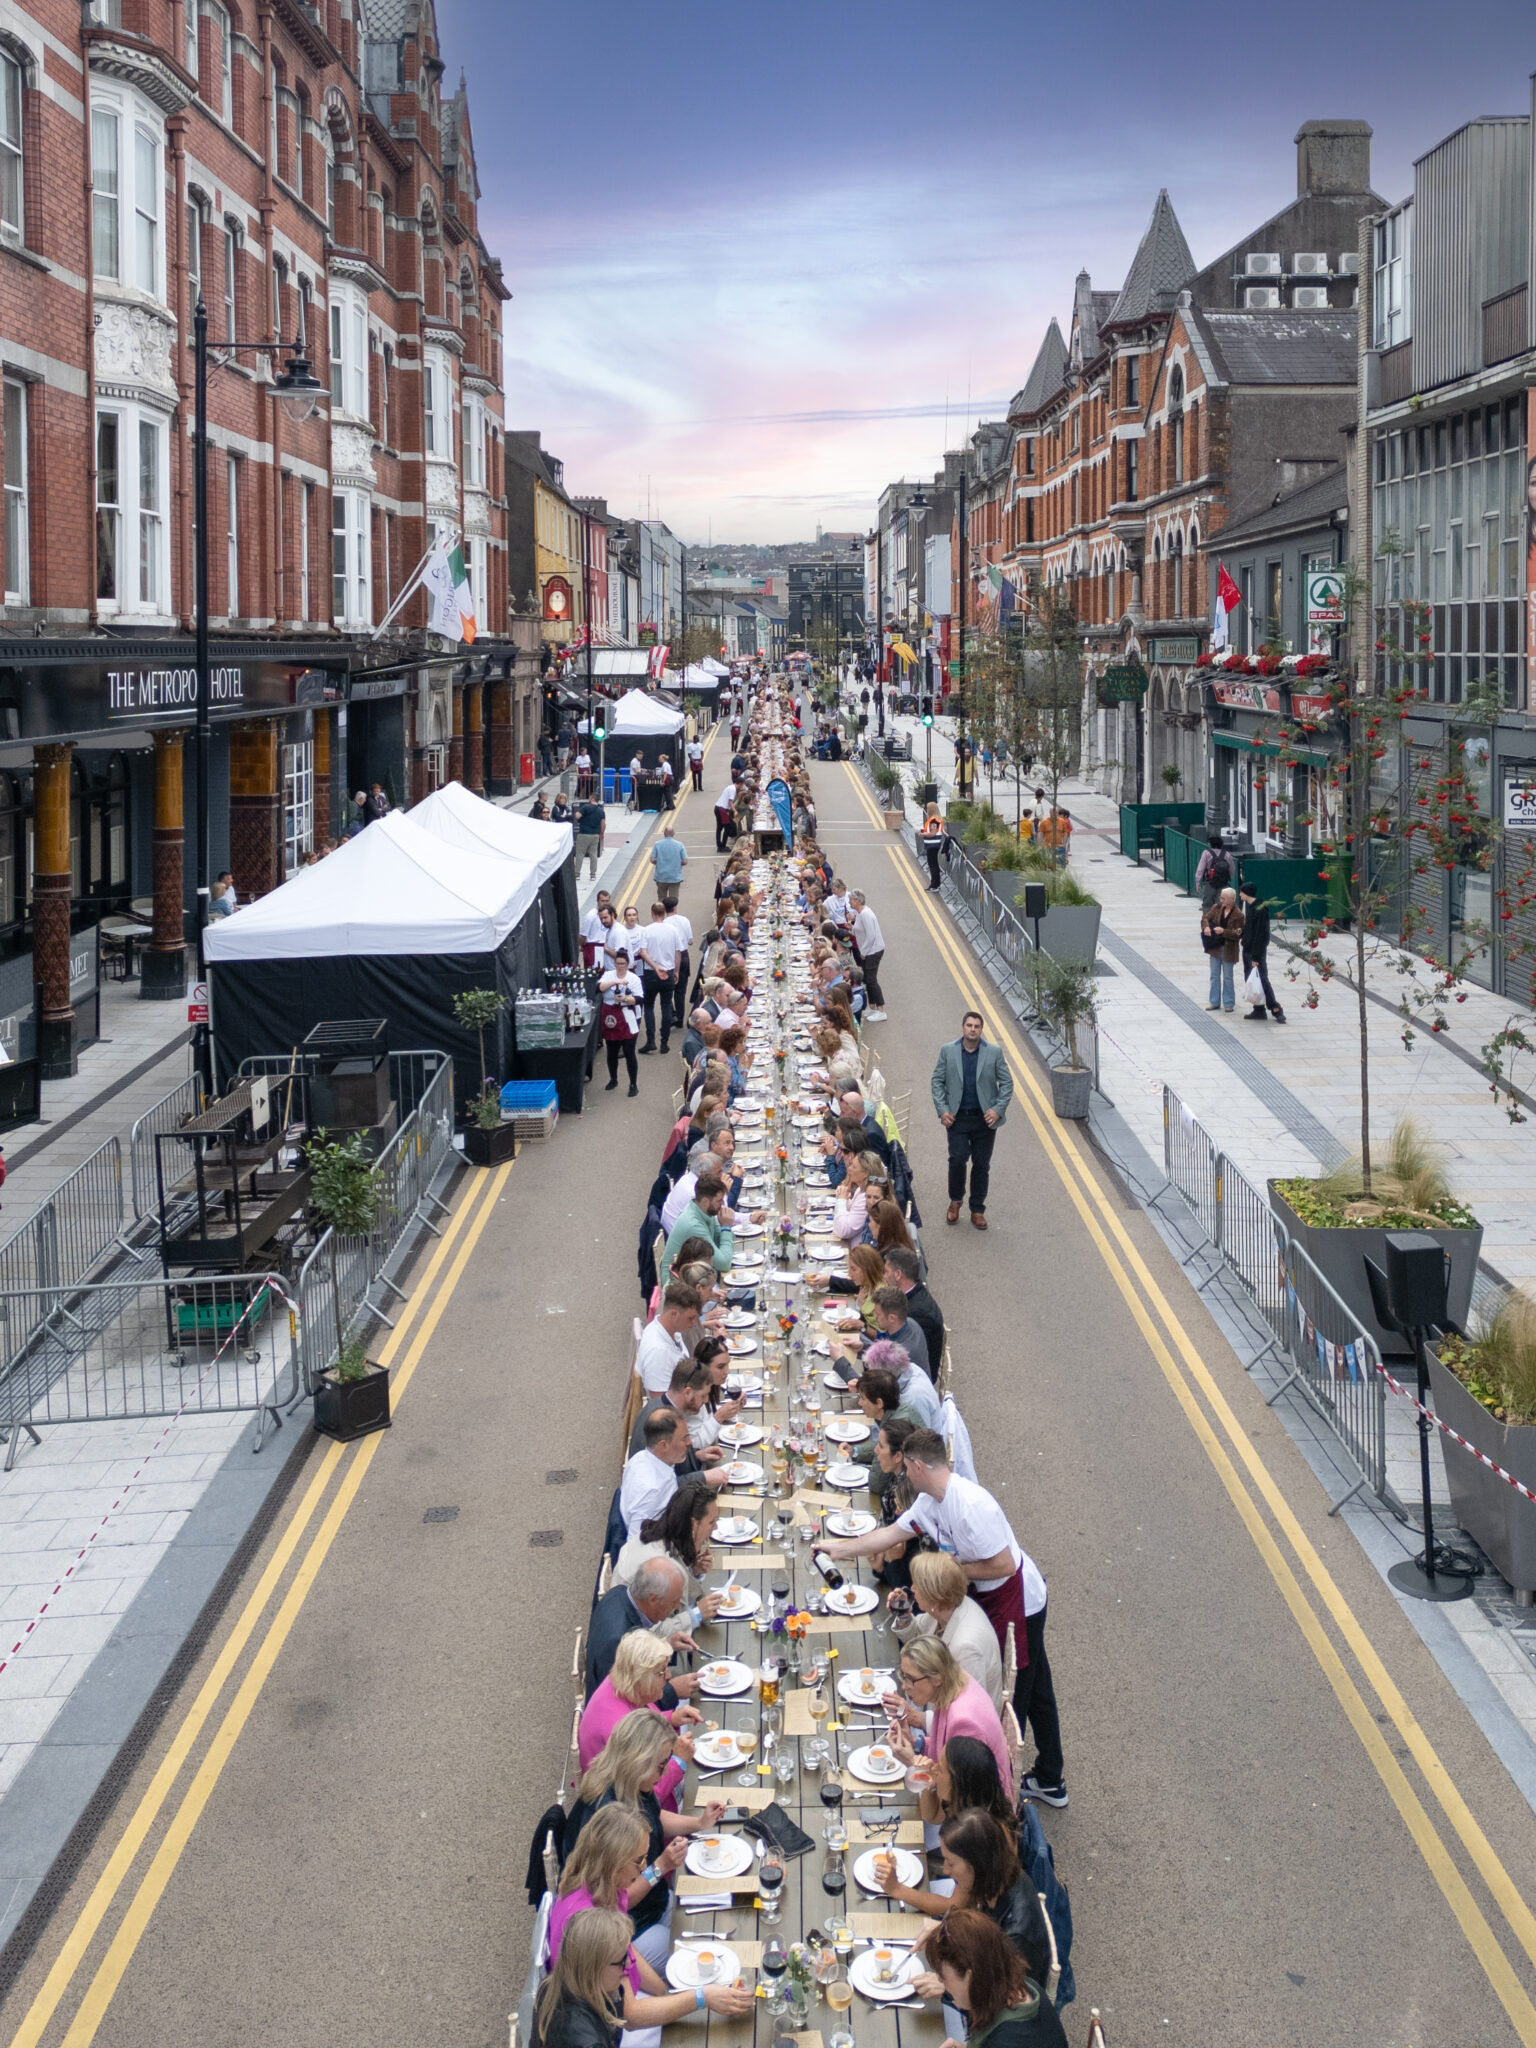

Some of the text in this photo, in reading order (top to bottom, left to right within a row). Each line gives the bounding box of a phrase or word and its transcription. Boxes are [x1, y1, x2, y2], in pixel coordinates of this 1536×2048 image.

[108, 667, 244, 708] THE METROPO HOTEL
